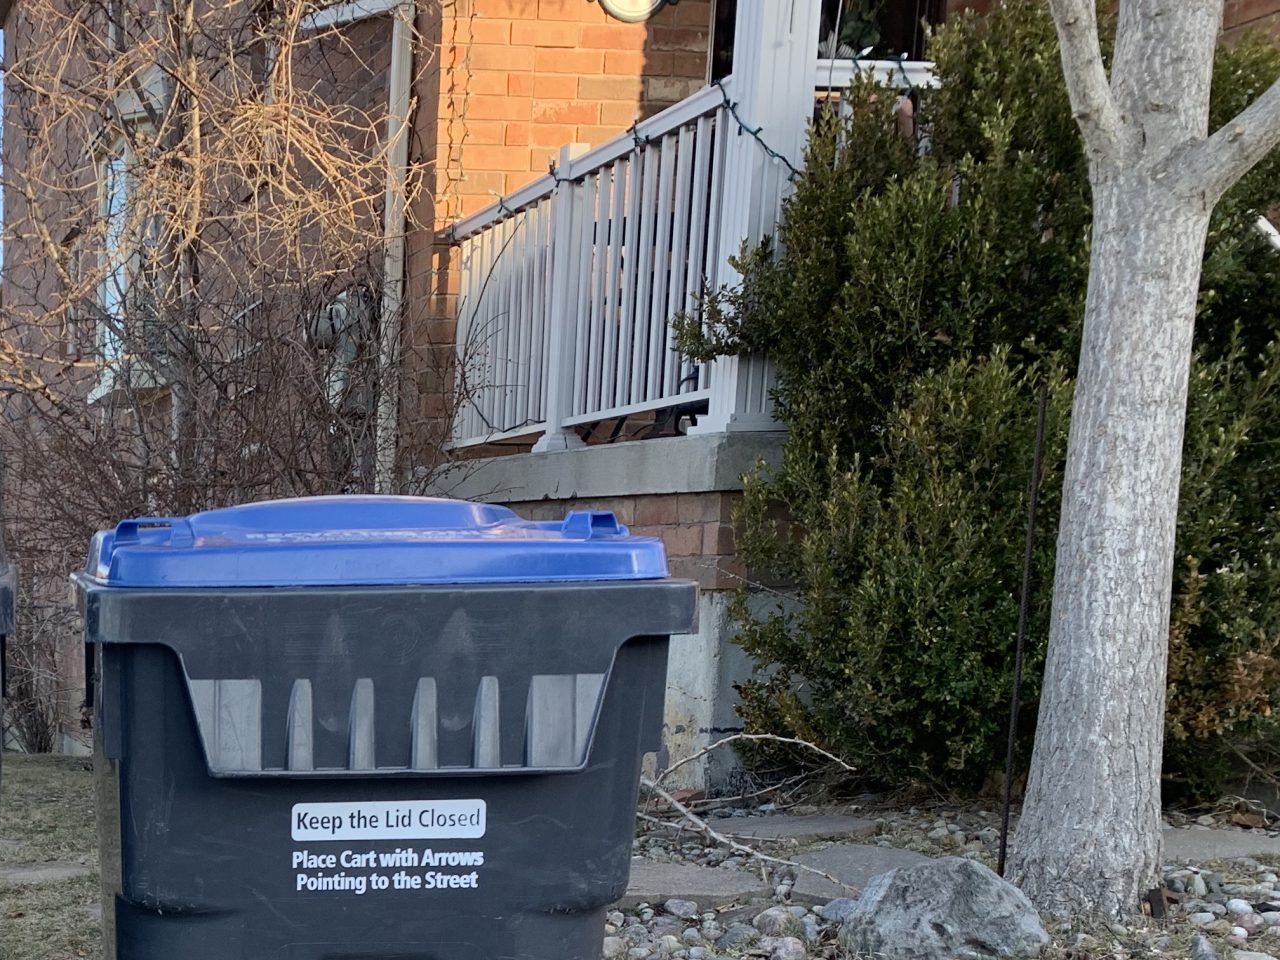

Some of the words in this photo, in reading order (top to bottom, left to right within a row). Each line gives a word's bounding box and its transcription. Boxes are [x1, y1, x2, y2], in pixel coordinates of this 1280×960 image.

[296, 811, 343, 834] Keep
[348, 810, 379, 829] the
[385, 809, 412, 828] Lid
[418, 808, 481, 828] Closed
[292, 850, 337, 869] Place
[339, 850, 377, 869] Cart
[379, 848, 419, 867] with
[420, 848, 485, 867] Arrows
[296, 872, 367, 894] Pointing
[369, 874, 390, 890] to
[392, 871, 422, 889] the
[424, 871, 479, 889] Street
